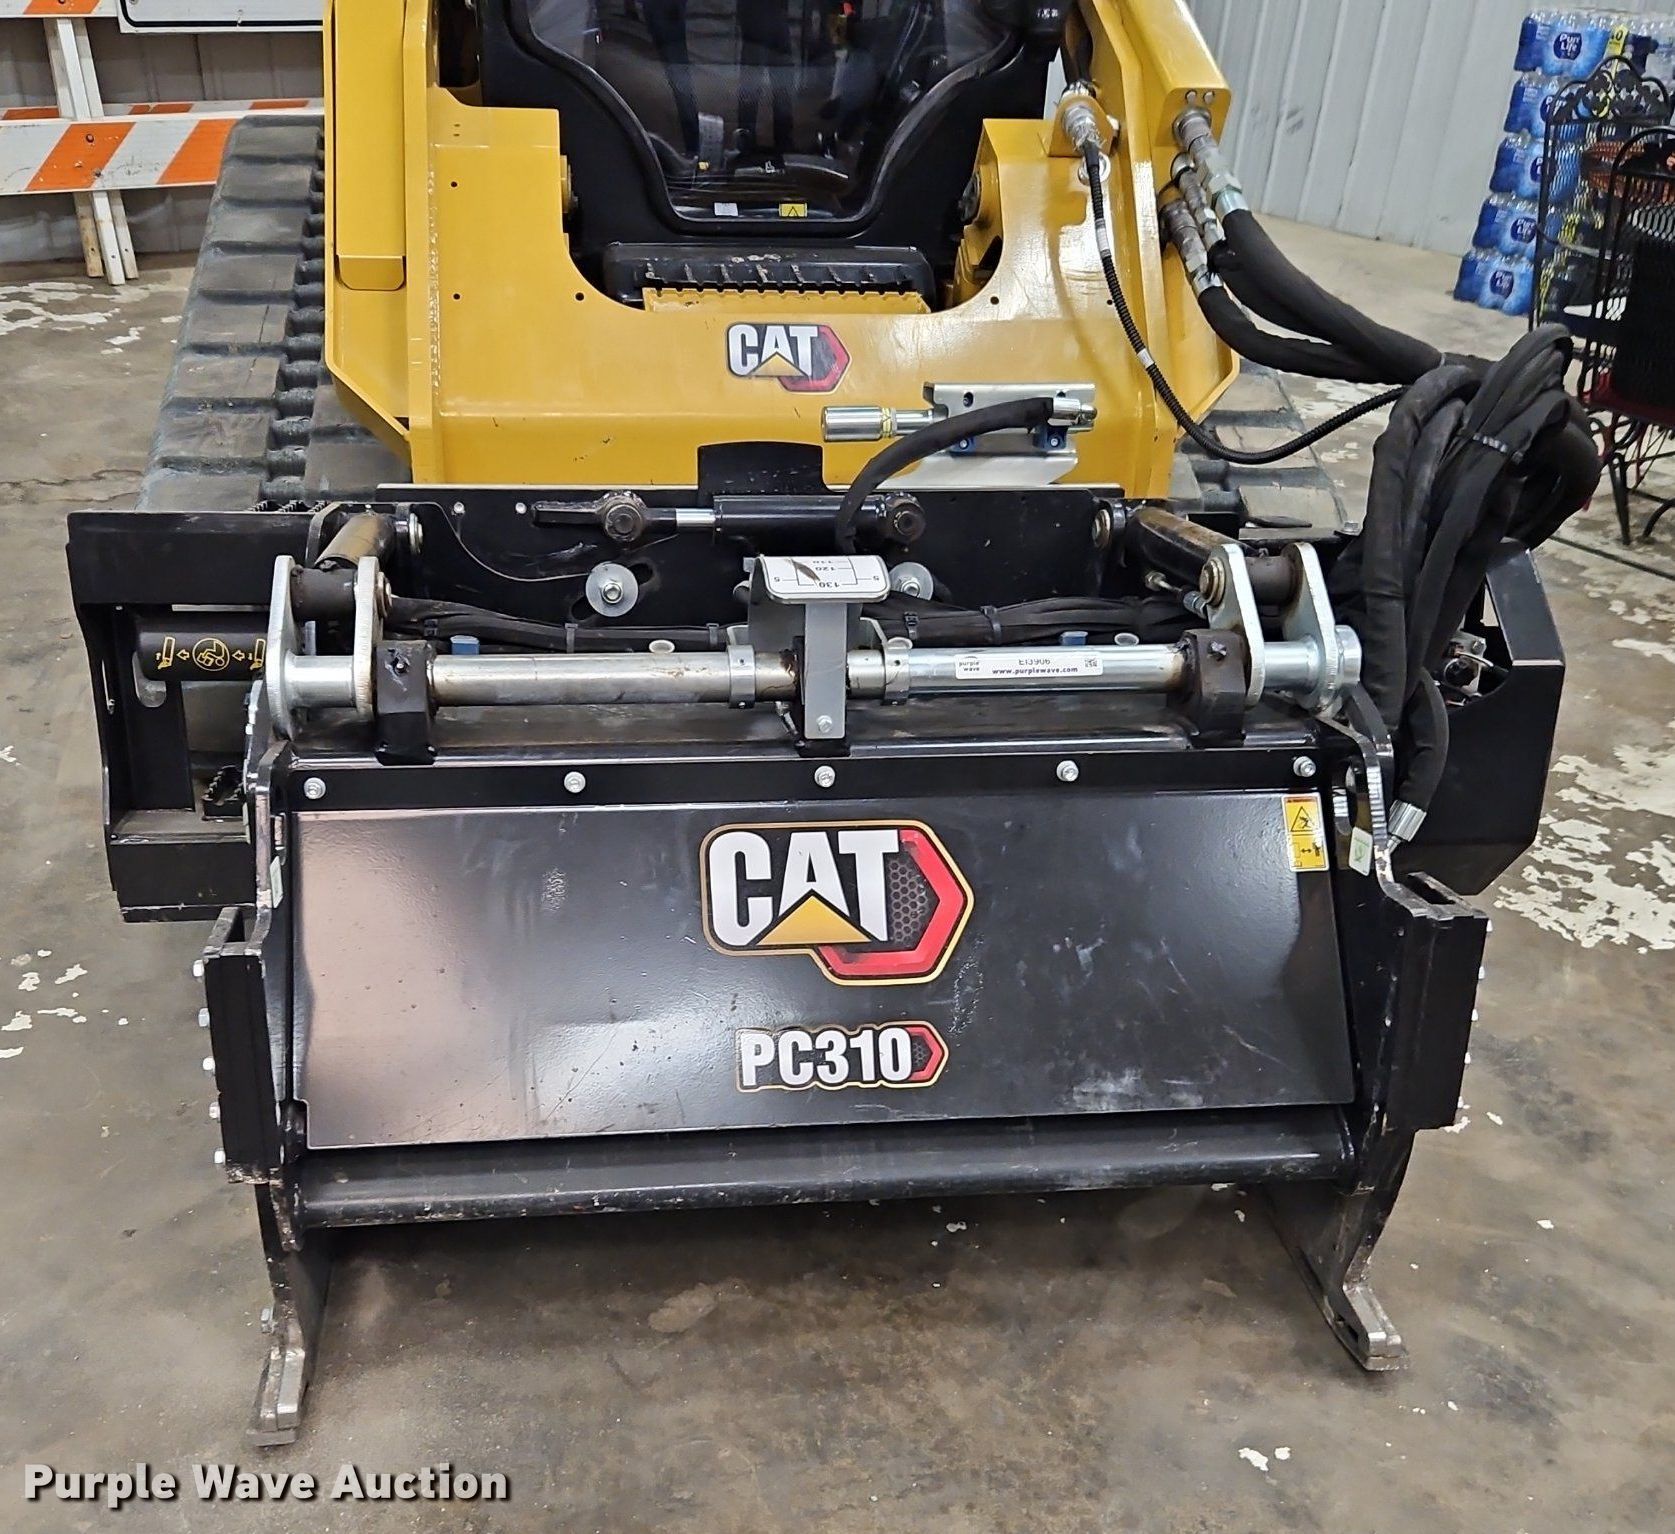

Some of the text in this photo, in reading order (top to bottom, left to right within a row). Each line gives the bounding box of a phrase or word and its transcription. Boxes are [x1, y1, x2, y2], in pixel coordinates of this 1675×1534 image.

[728, 324, 818, 376] CAT
[992, 666, 1078, 675] www.purplewave.com
[709, 829, 900, 946] CAT
[740, 1027, 912, 1087] PC310
